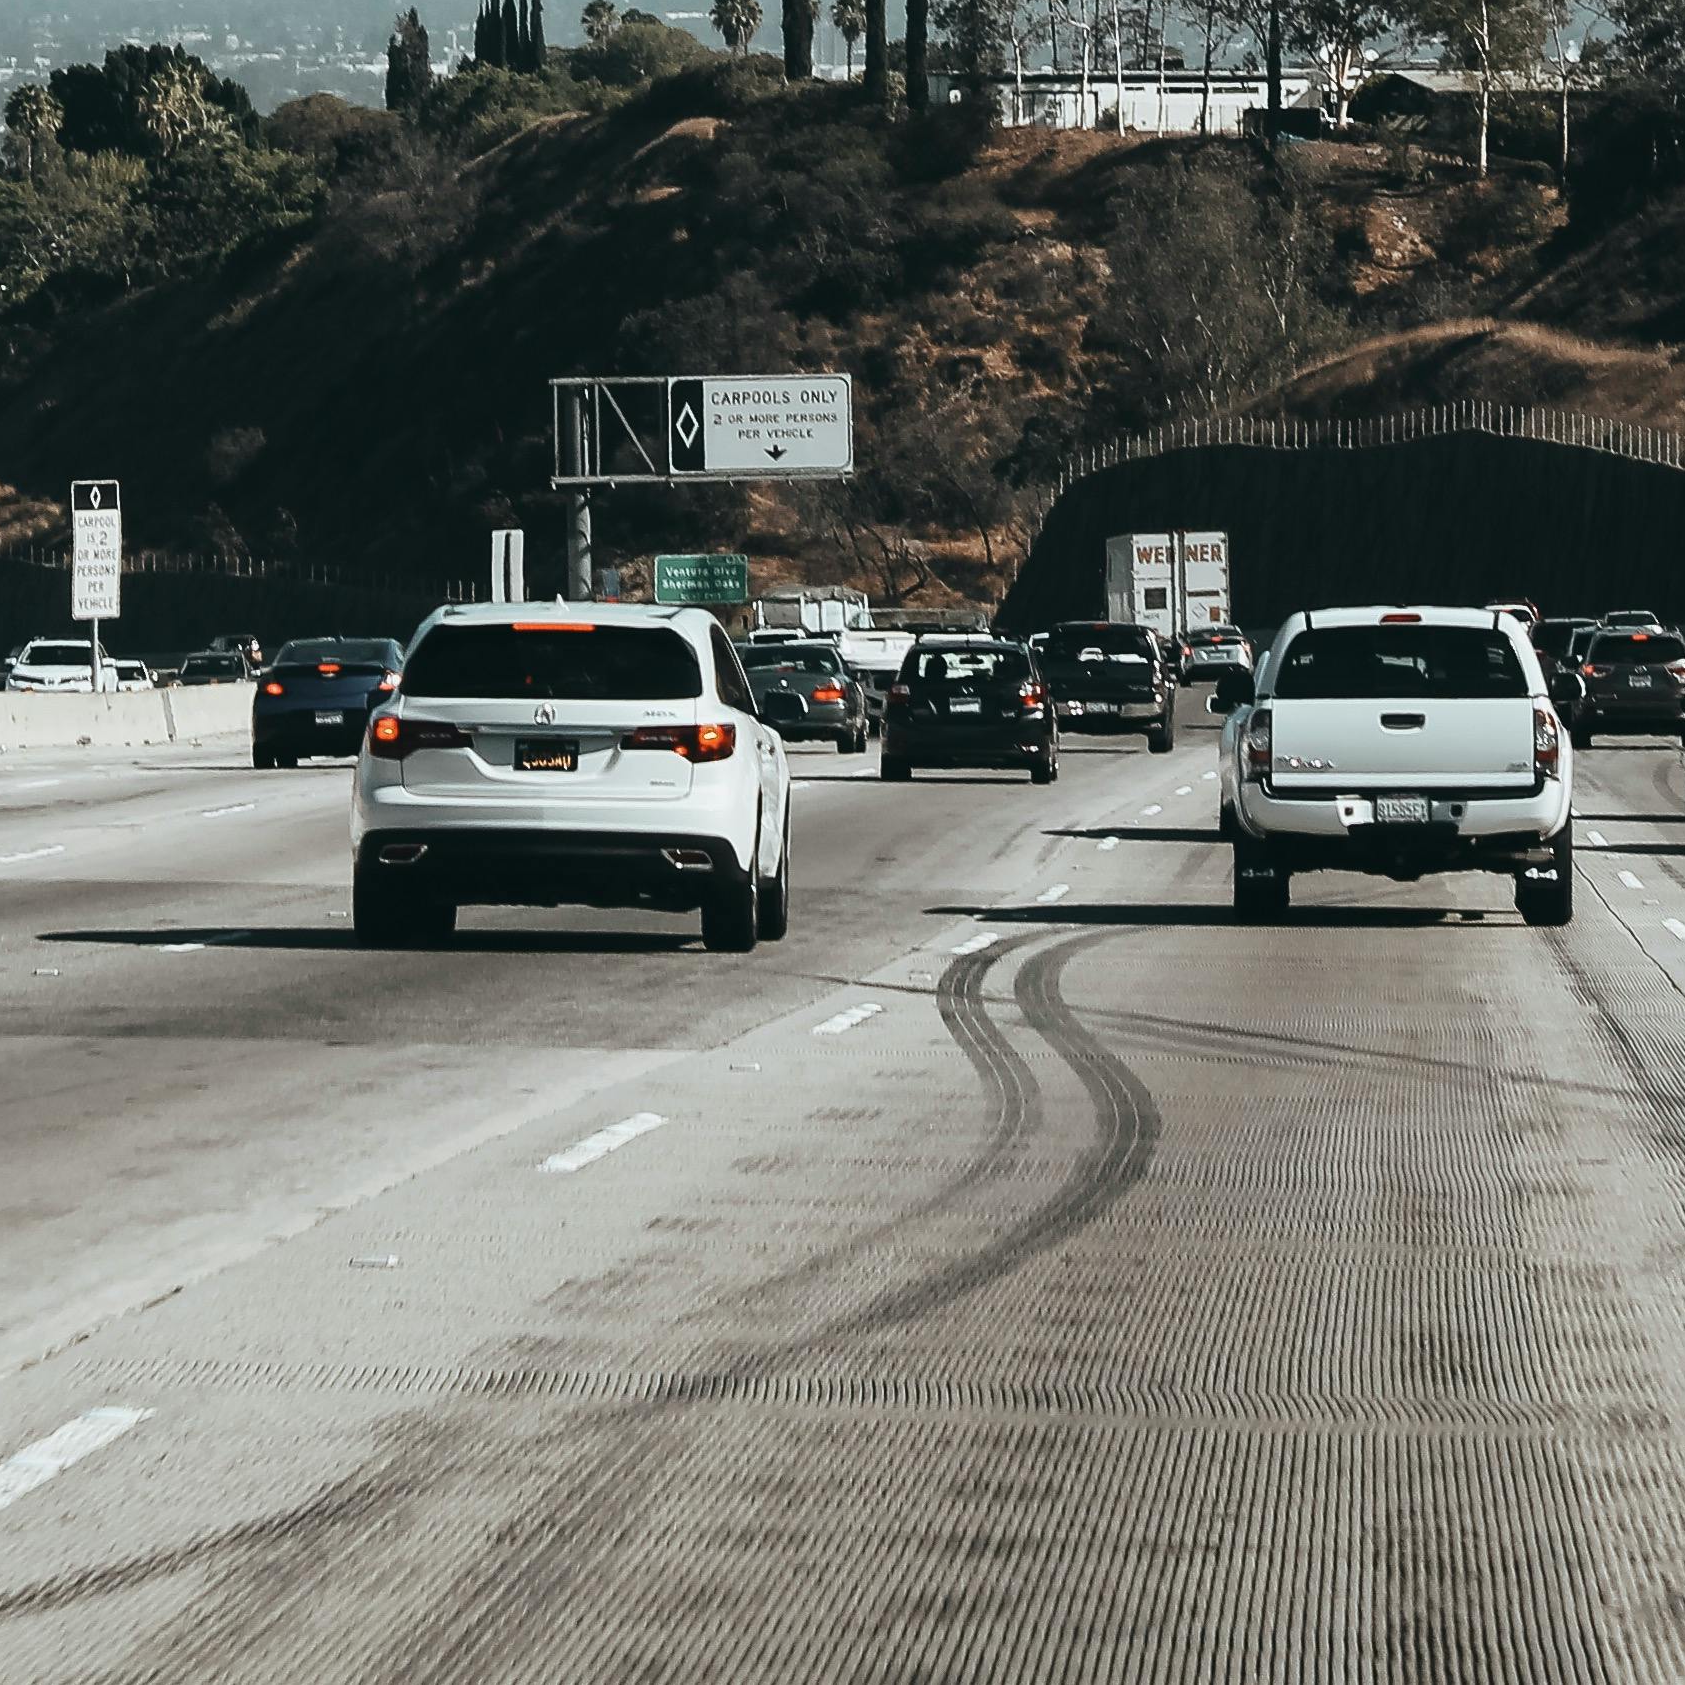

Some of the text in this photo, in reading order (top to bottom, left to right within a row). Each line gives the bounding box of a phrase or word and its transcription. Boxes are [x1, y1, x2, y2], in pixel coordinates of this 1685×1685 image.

[711, 389, 837, 406] CARPOOLS ONLY
[713, 411, 838, 426] 2 OR MORE PERSONS
[738, 428, 815, 440] PER VEHICLE
[77, 516, 116, 529] CARPOOL
[99, 530, 108, 546] 2
[77, 548, 117, 561] OR MORE
[76, 564, 117, 577] PERSONS
[665, 565, 709, 577] Ventura
[87, 581, 104, 593] PER
[77, 597, 114, 610] VEHICLE
